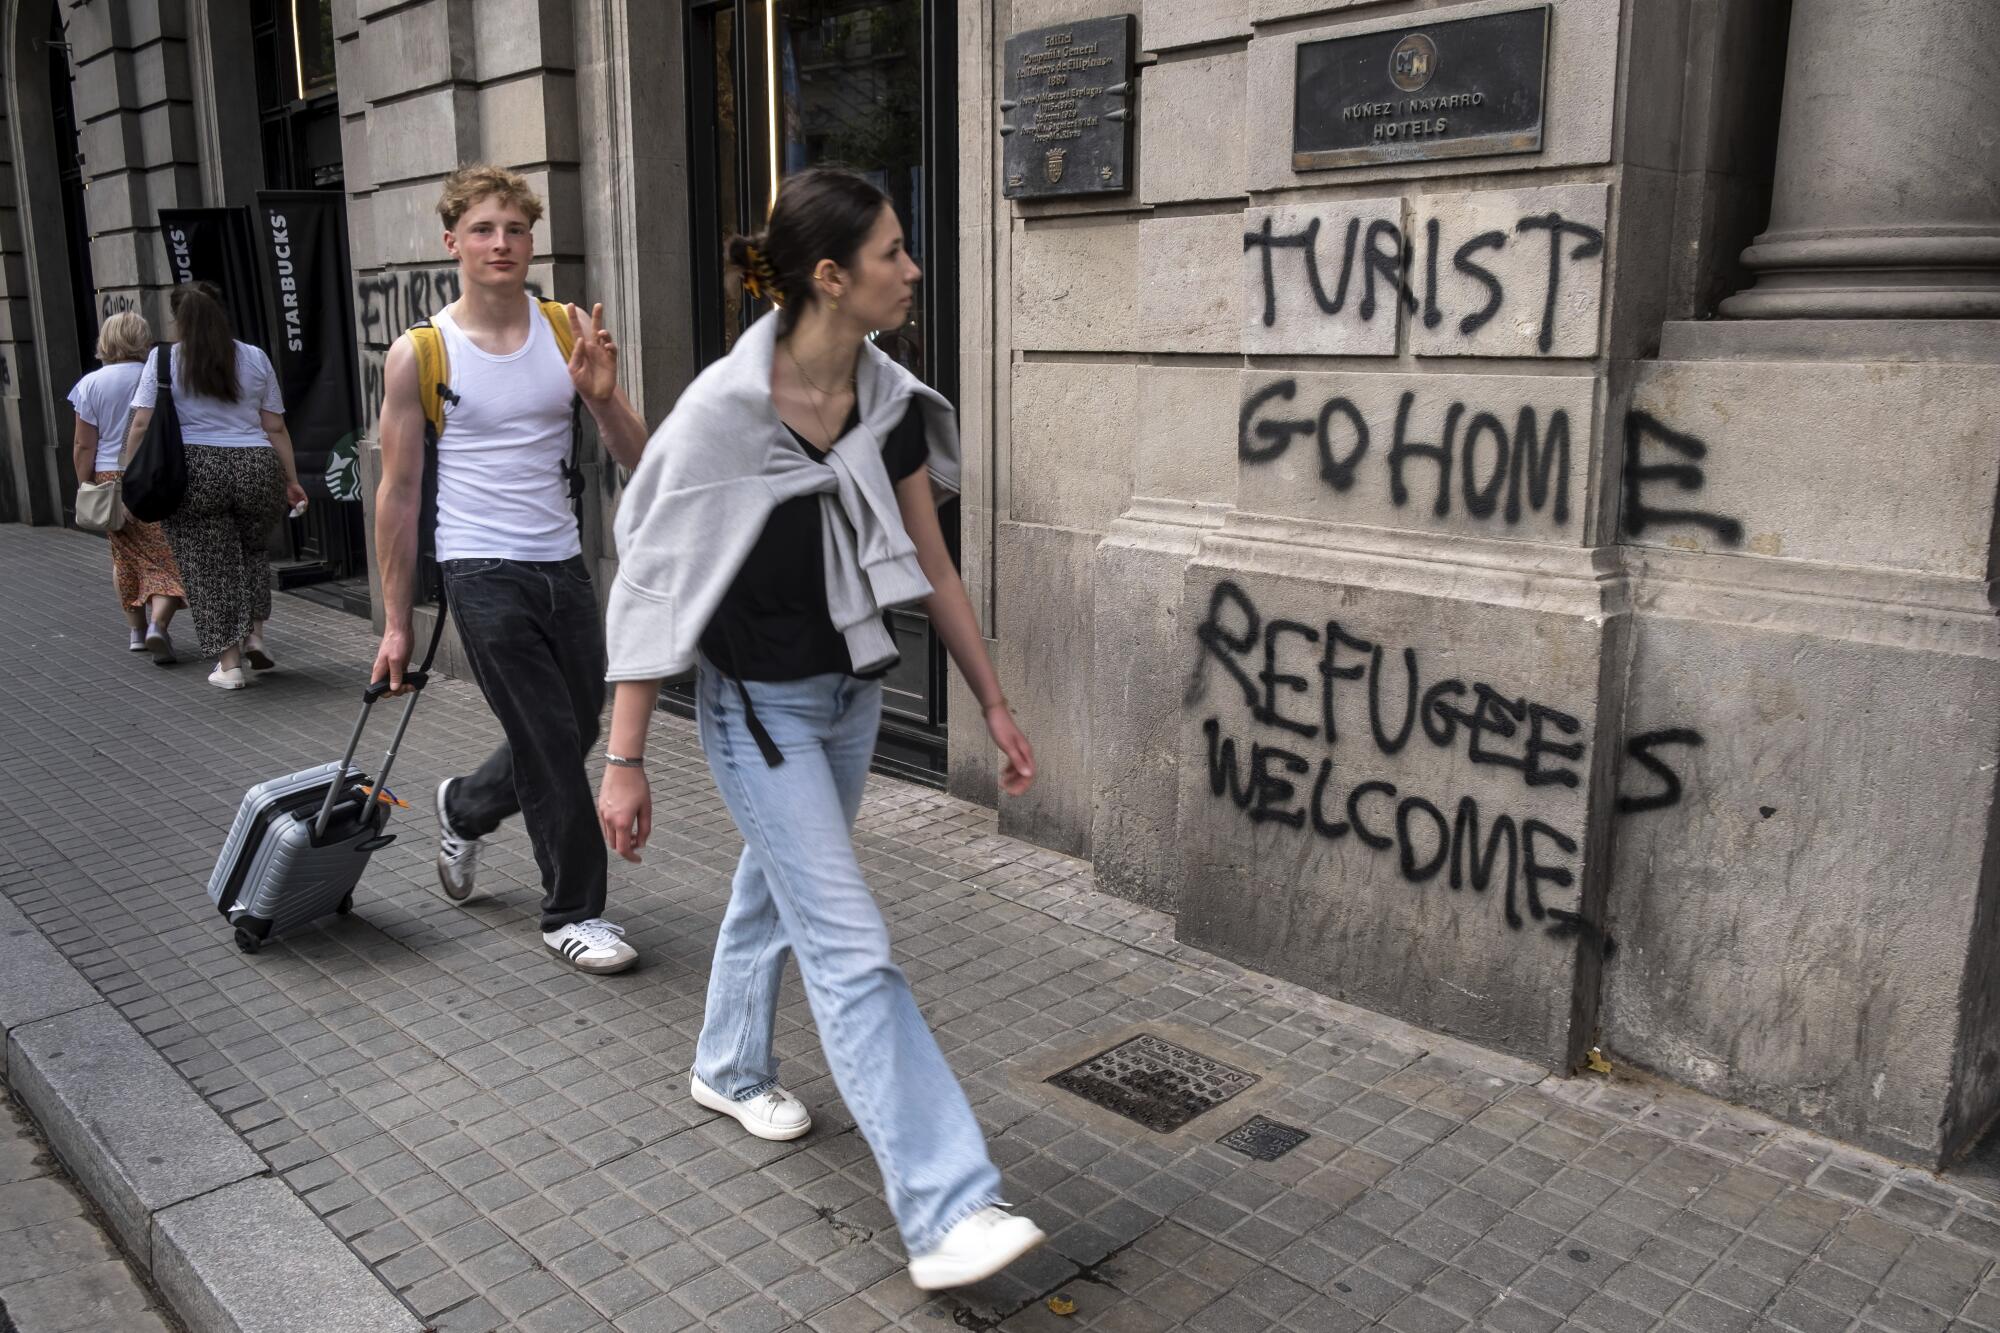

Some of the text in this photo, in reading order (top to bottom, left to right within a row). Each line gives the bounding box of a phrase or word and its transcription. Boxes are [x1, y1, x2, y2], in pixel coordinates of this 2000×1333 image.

[1373, 117, 1448, 138] HOTELS
[1409, 92, 1485, 115] NAVARRO
[270, 214, 303, 352] STARBUCKS
[1243, 212, 1603, 353] TURIST
[1238, 379, 1371, 492] GO
[1203, 717, 1616, 961] WELCOME
